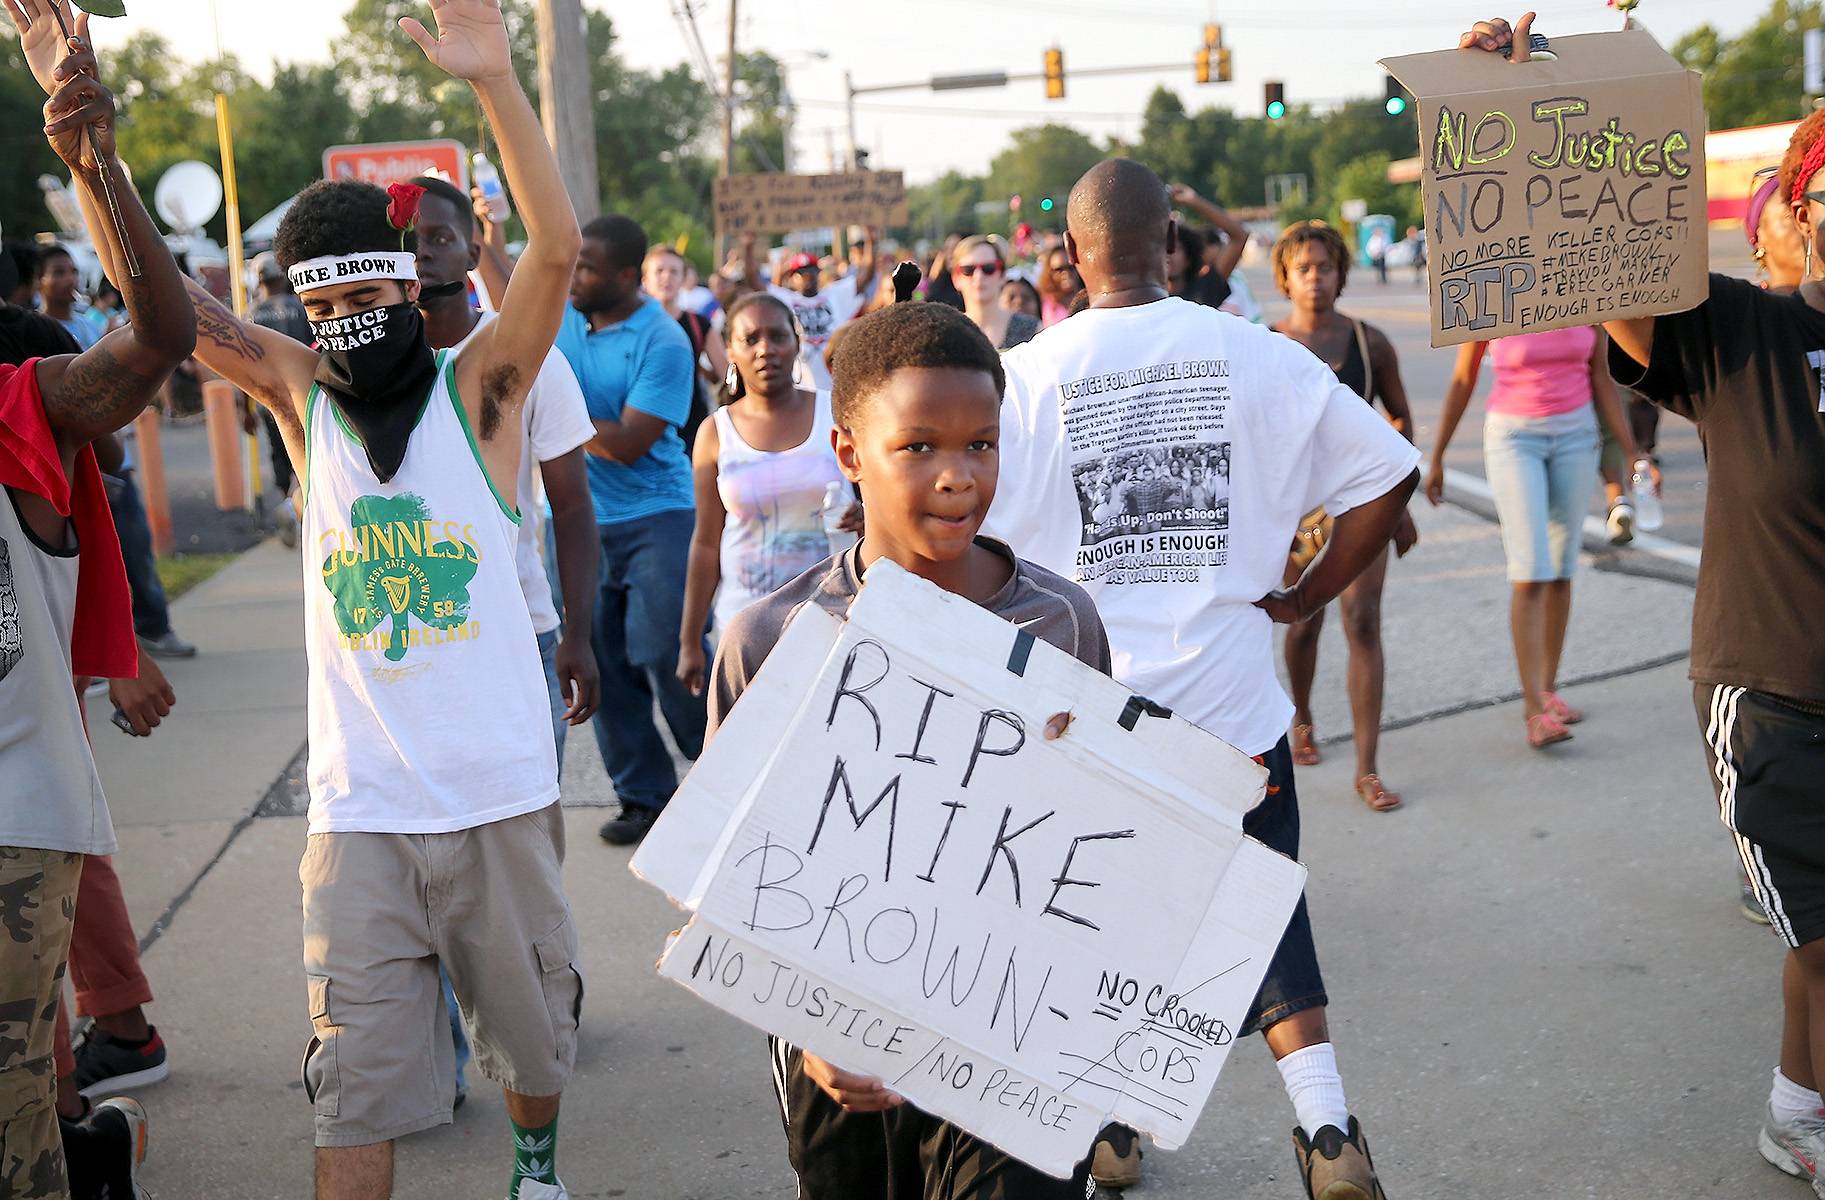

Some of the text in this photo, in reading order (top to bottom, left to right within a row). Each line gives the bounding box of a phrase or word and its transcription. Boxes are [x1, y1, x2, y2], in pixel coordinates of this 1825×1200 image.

[1432, 97, 1691, 180] NO Justice
[1435, 174, 1688, 243] NO PEACE
[335, 258, 396, 277] BROWN
[1441, 250, 1468, 272] NO
[1475, 236, 1531, 259] MORE
[1547, 225, 1616, 249] KILLER
[1440, 263, 1537, 330] RIP
[1602, 266, 1671, 291] GARNER
[319, 307, 389, 336] JUSTICE
[1521, 297, 1588, 328] ENOUGH
[1596, 296, 1615, 312] IS
[329, 325, 386, 351] PEACE
[1060, 360, 1229, 406] JUSTICE FOR MICHAEL BROWN
[1119, 515, 1145, 529] Up,
[1147, 508, 1182, 523] Don't
[319, 519, 483, 577] GUINNESS
[385, 559, 406, 569] GATE
[1076, 538, 1135, 566] ENOUGH
[1141, 537, 1154, 554] IS
[1076, 566, 1096, 582] AN
[1126, 568, 1168, 585] VALUE
[400, 620, 480, 649] IRELAND
[826, 638, 1026, 788] RIP
[807, 755, 1136, 931] MIKE
[1097, 970, 1232, 1046] NO CROOKED
[691, 934, 744, 988] NO
[753, 960, 915, 1056] JUSTICE
[980, 1069, 1077, 1132] PEACE
[1115, 1031, 1200, 1083] COPS
